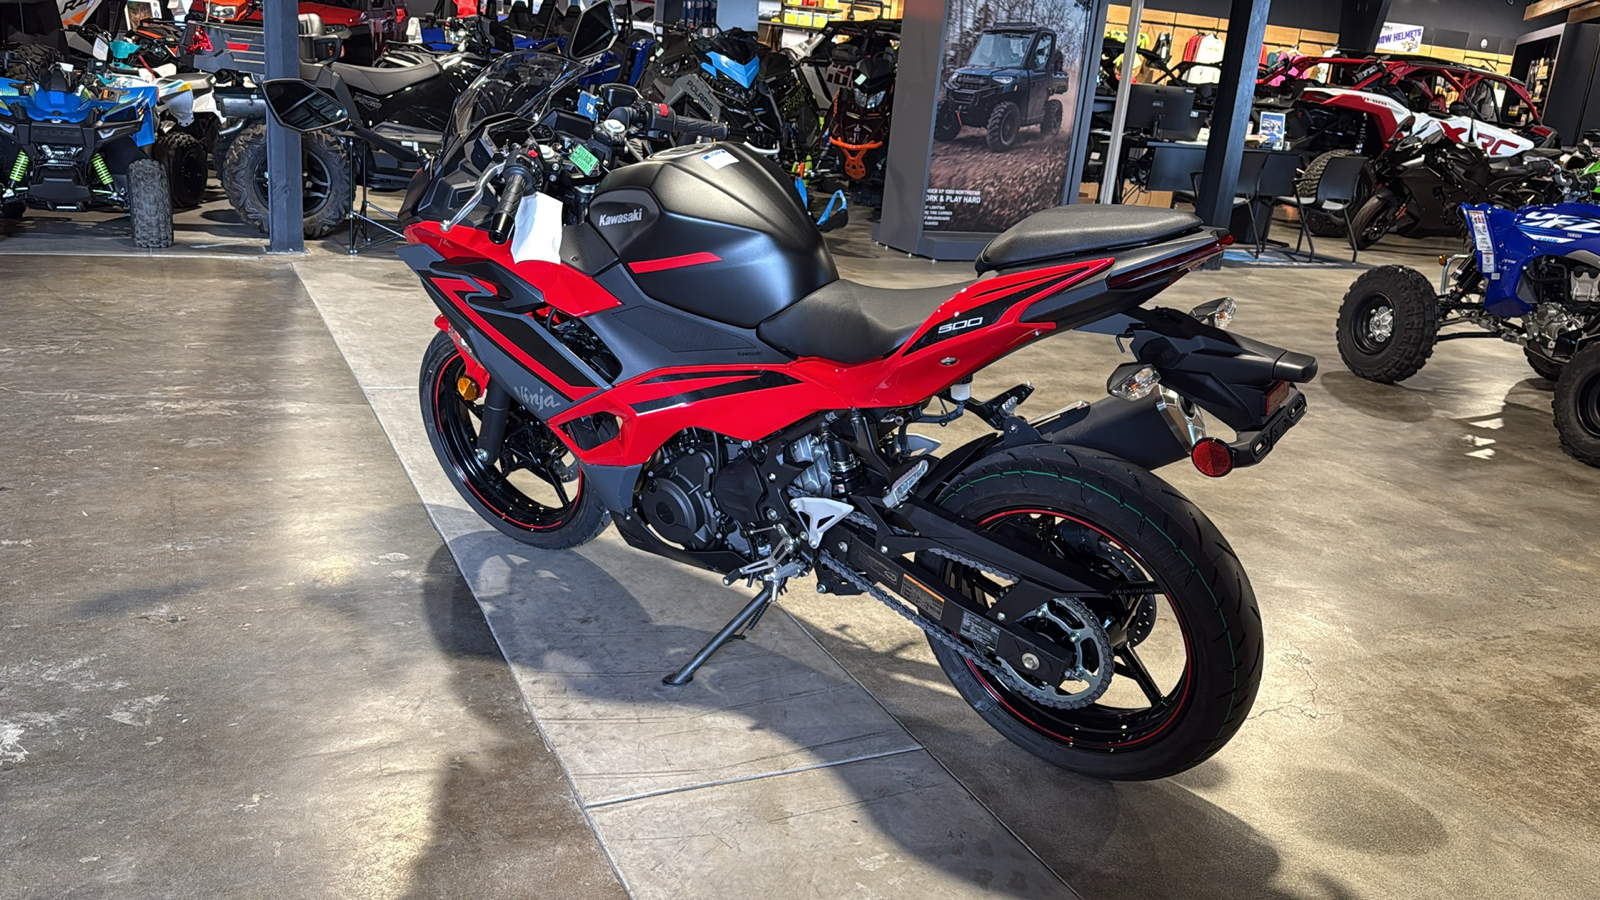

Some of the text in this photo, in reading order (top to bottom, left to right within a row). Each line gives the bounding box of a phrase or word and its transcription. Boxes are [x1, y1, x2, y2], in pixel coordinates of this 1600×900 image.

[1393, 29, 1421, 42] HELMETS
[686, 80, 714, 111] POLARIS
[598, 208, 643, 227] Kawasaki
[938, 316, 984, 334] 500
[513, 385, 562, 412] Ninja
